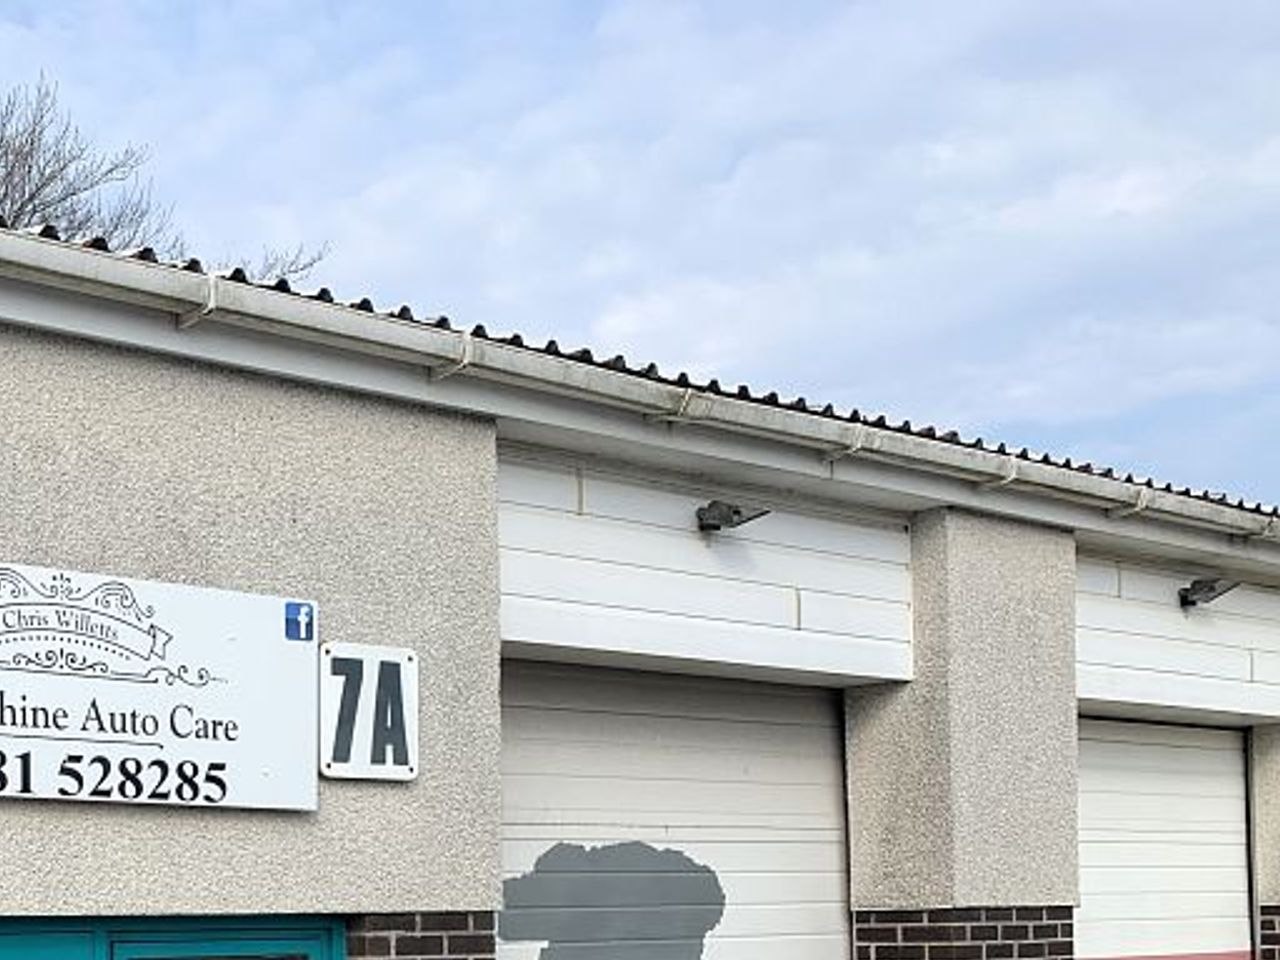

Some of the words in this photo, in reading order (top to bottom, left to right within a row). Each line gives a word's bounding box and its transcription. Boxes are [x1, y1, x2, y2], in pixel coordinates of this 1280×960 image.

[2, 609, 49, 629] Chris
[54, 609, 119, 640] Willetts
[80, 697, 159, 736] Auto
[169, 703, 239, 741] Care
[330, 656, 409, 766] 7A
[57, 754, 227, 803] 528285
